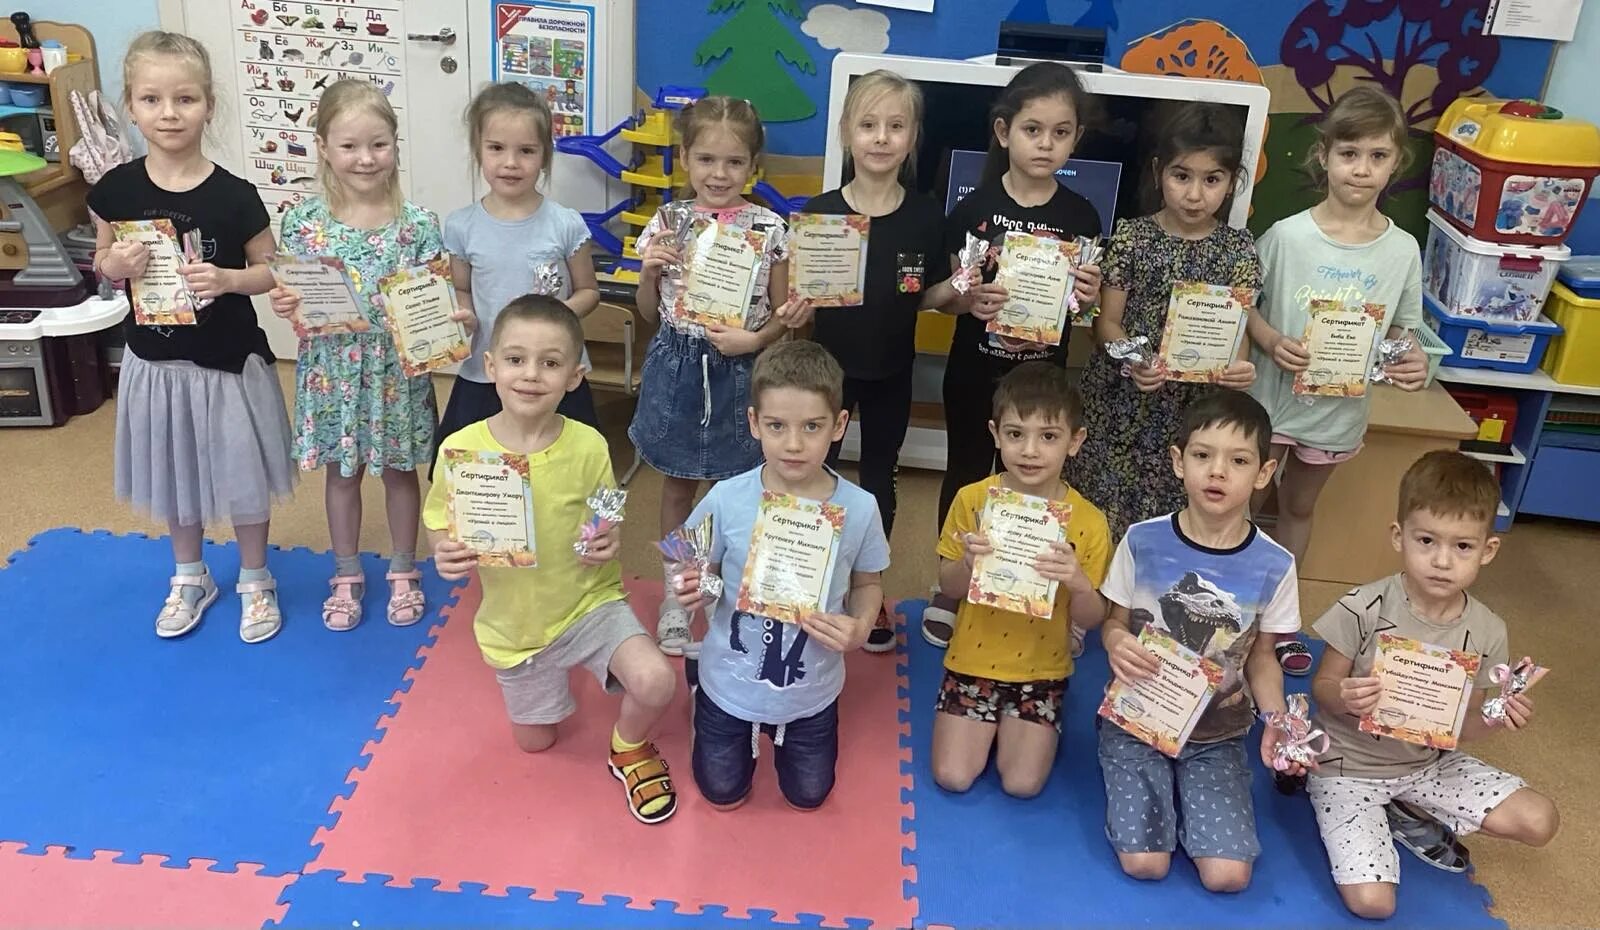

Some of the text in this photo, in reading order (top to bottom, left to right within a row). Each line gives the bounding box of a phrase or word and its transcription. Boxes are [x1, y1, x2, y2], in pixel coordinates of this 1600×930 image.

[272, 2, 288, 13] Бб
[304, 5, 320, 16] Вв
[337, 8, 349, 17] Гг
[366, 10, 382, 22] Дд
[520, 16, 586, 28] ПРАВИЛА ДОРОЖНОЙ
[538, 24, 586, 34] БЕЗОПАСНОСТИ
[244, 33, 258, 43] Ее
[305, 37, 325, 48] Жж
[341, 41, 354, 51] Зз
[368, 43, 383, 53] Ии
[246, 64, 262, 75] Йй
[276, 67, 288, 77] Кк
[305, 69, 320, 80] Лл
[250, 97, 265, 107] Оо
[279, 99, 293, 110] Пп
[252, 129, 298, 142] Уу Фф
[255, 159, 306, 174] Шш Щщ
[398, 280, 437, 295] Сертификат
[1187, 299, 1232, 310] Сертификат
[1321, 317, 1365, 326] Сертификат
[460, 471, 508, 483] Сертификат
[772, 514, 820, 531] Сертификат
[1000, 509, 1048, 526] Сертификат
[797, 540, 826, 552] Михаилу
[1149, 649, 1194, 679] Сртификат
[1392, 655, 1450, 674] Сертификат
[1431, 680, 1462, 691] Максиму
